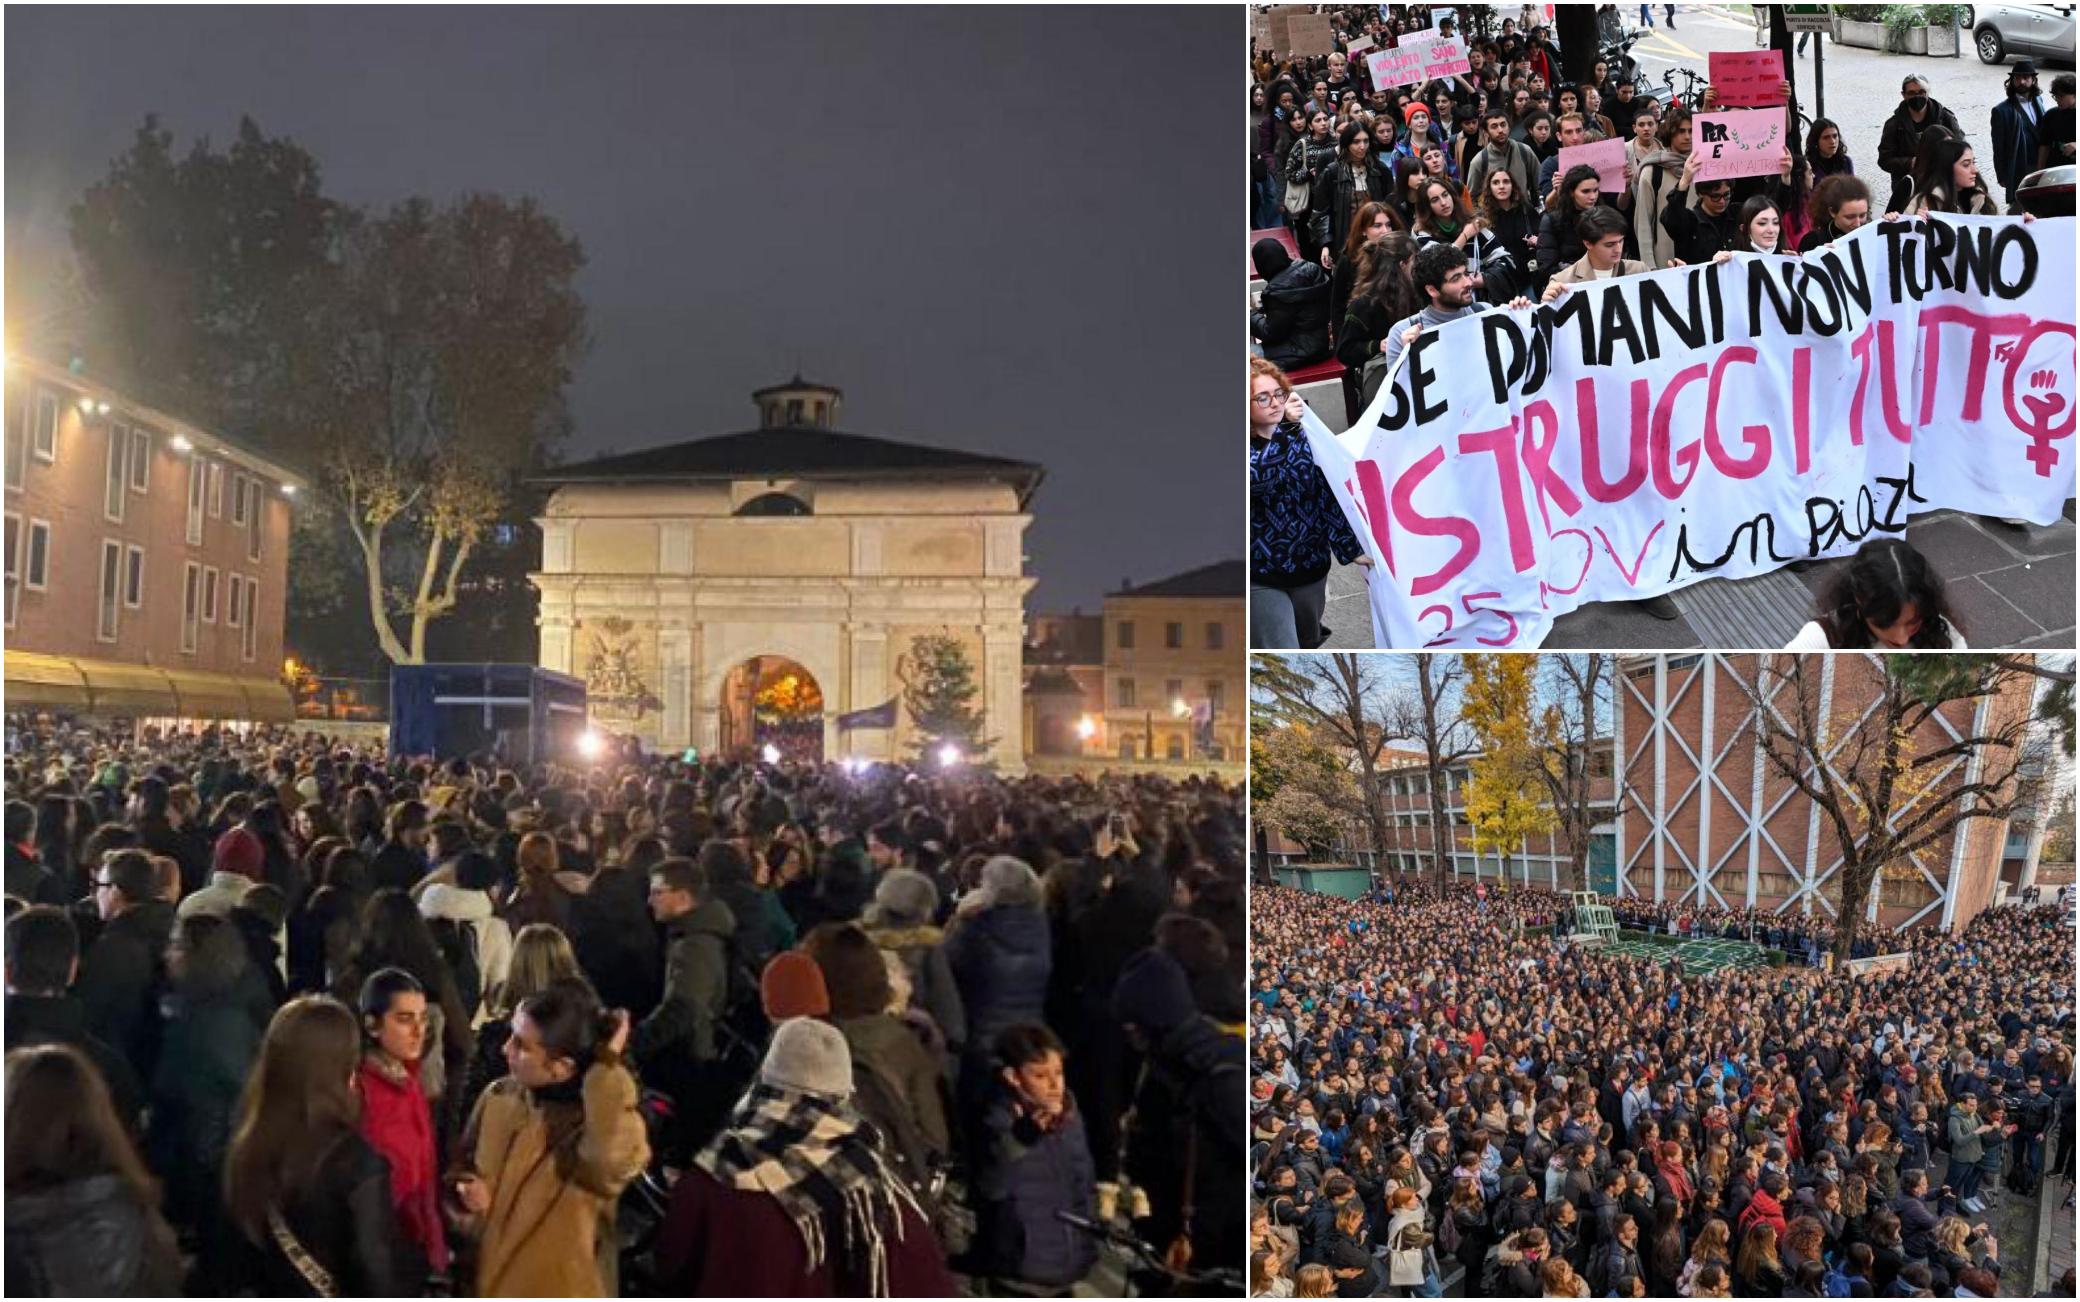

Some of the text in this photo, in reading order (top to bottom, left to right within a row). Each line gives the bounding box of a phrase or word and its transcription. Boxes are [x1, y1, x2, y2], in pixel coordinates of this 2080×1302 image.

[1431, 45, 1457, 60] SANO
[1701, 121, 1730, 143] PER
[1712, 144, 1724, 159] E
[1377, 329, 1449, 431] SE
[1747, 238, 1872, 338] NON
[1345, 304, 2076, 597] ISTRUGGI TUTTO
[1418, 591, 1519, 647] 25
[1539, 519, 1666, 610] OV
[1666, 506, 1796, 584] in
